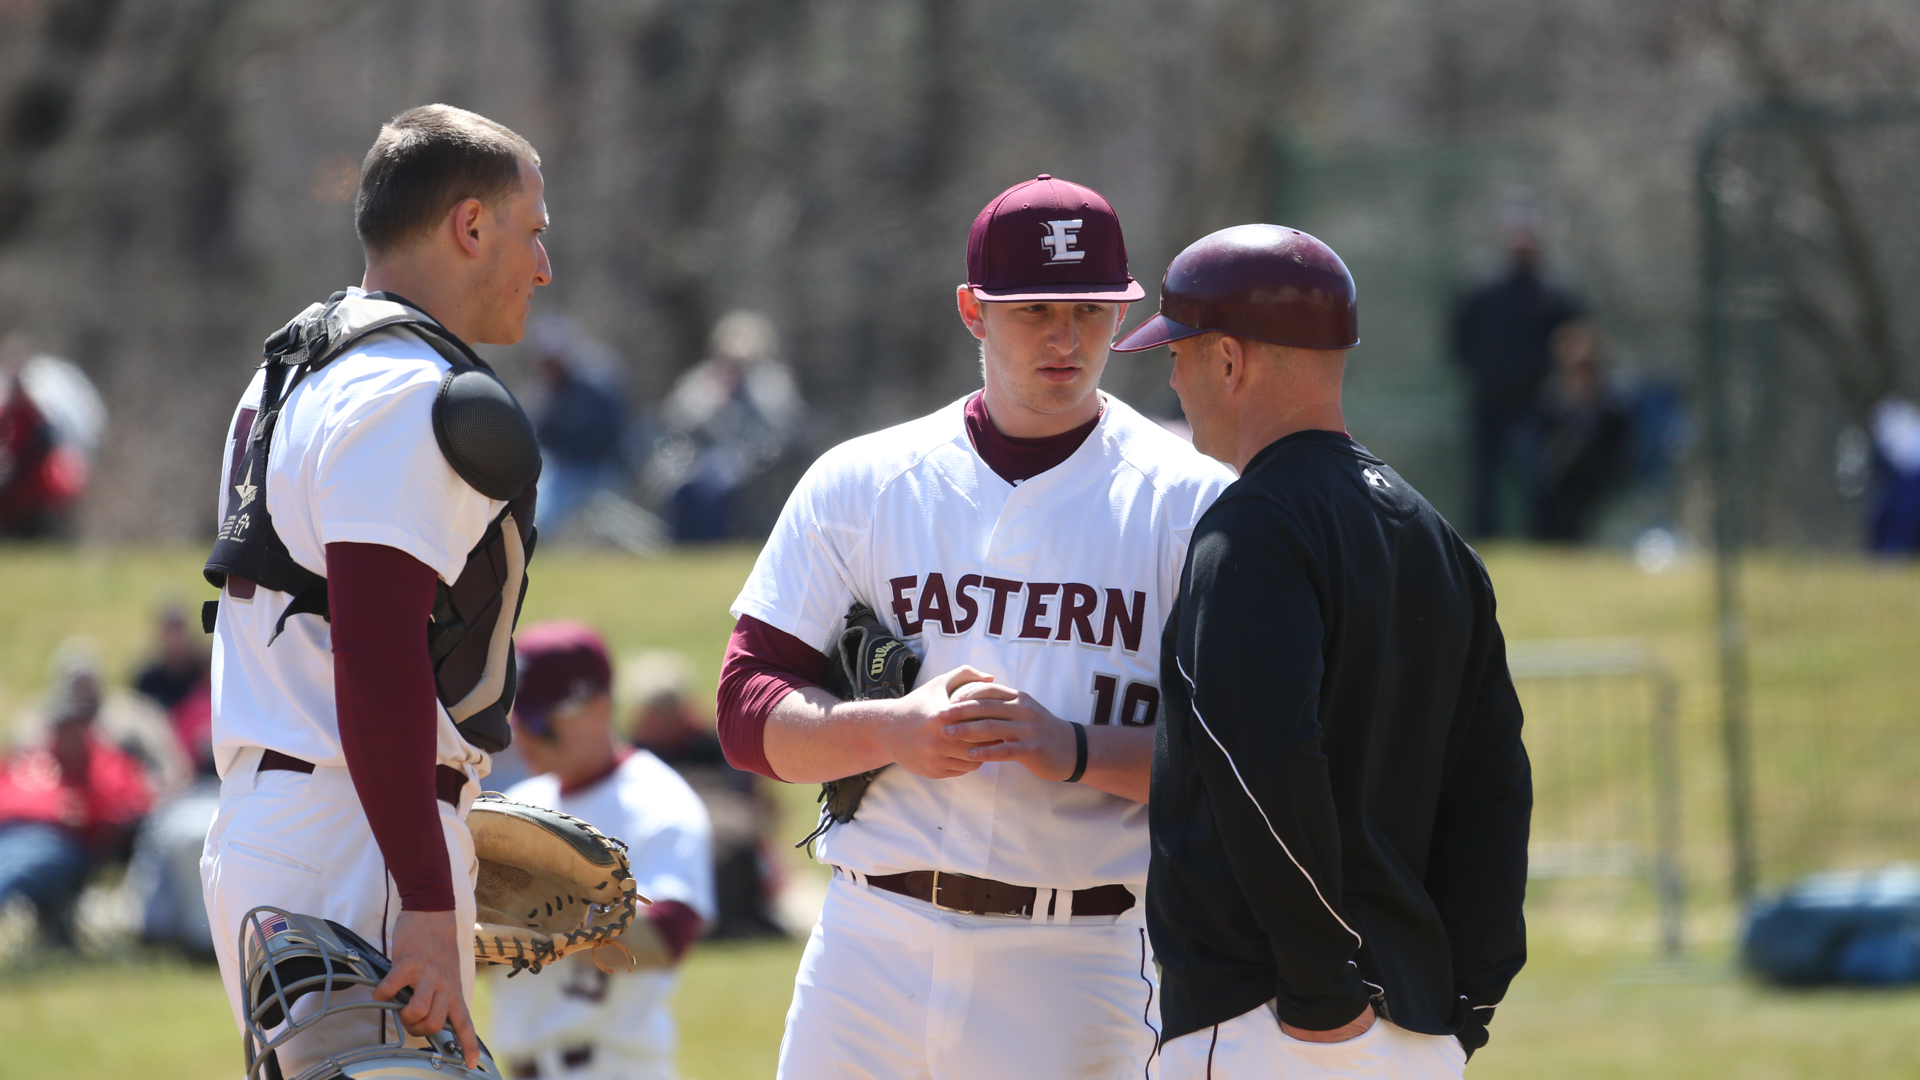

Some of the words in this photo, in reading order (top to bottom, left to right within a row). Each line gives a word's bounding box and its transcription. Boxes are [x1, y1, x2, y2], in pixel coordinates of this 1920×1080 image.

[1039, 219, 1086, 266] E
[888, 571, 1148, 654] EASTERN
[870, 639, 902, 676] Wilson
